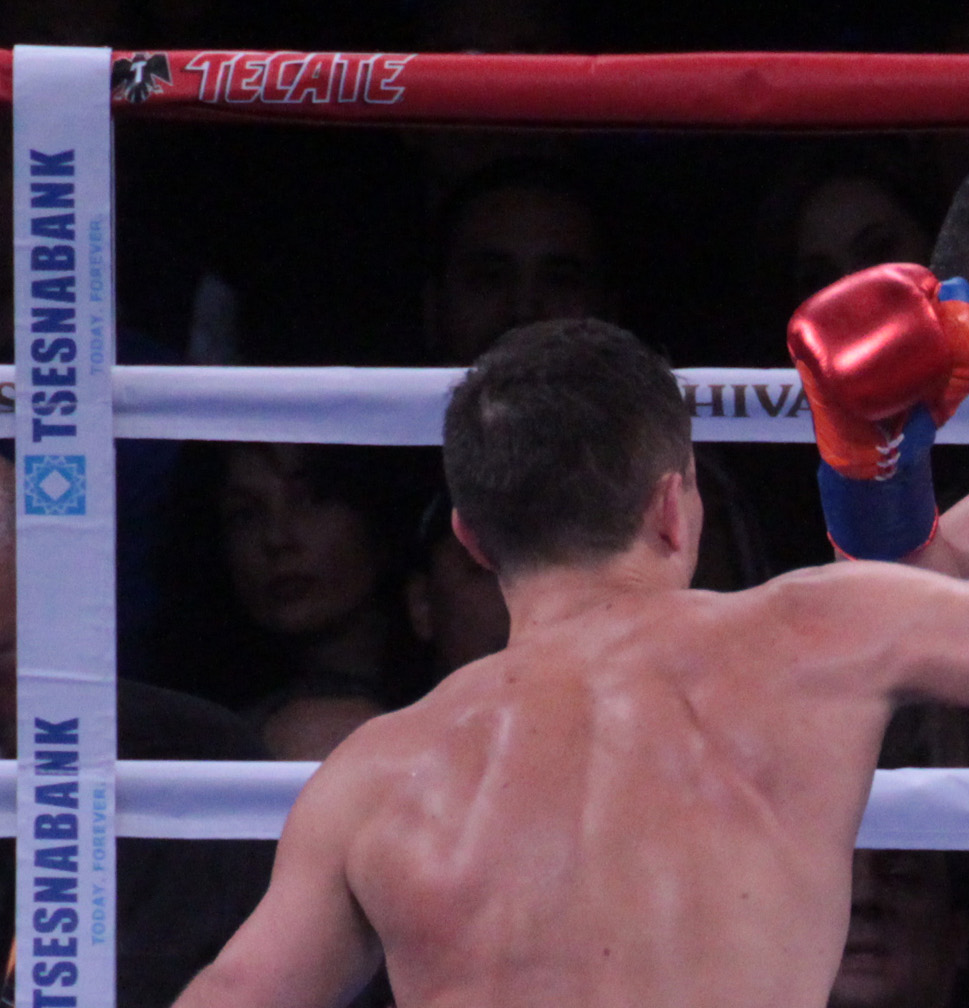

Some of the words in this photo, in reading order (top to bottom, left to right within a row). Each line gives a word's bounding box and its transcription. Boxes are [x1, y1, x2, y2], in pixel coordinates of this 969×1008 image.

[185, 51, 419, 104] TECATE
[30, 148, 77, 443] TSESNABANK
[674, 383, 813, 418] HIVA
